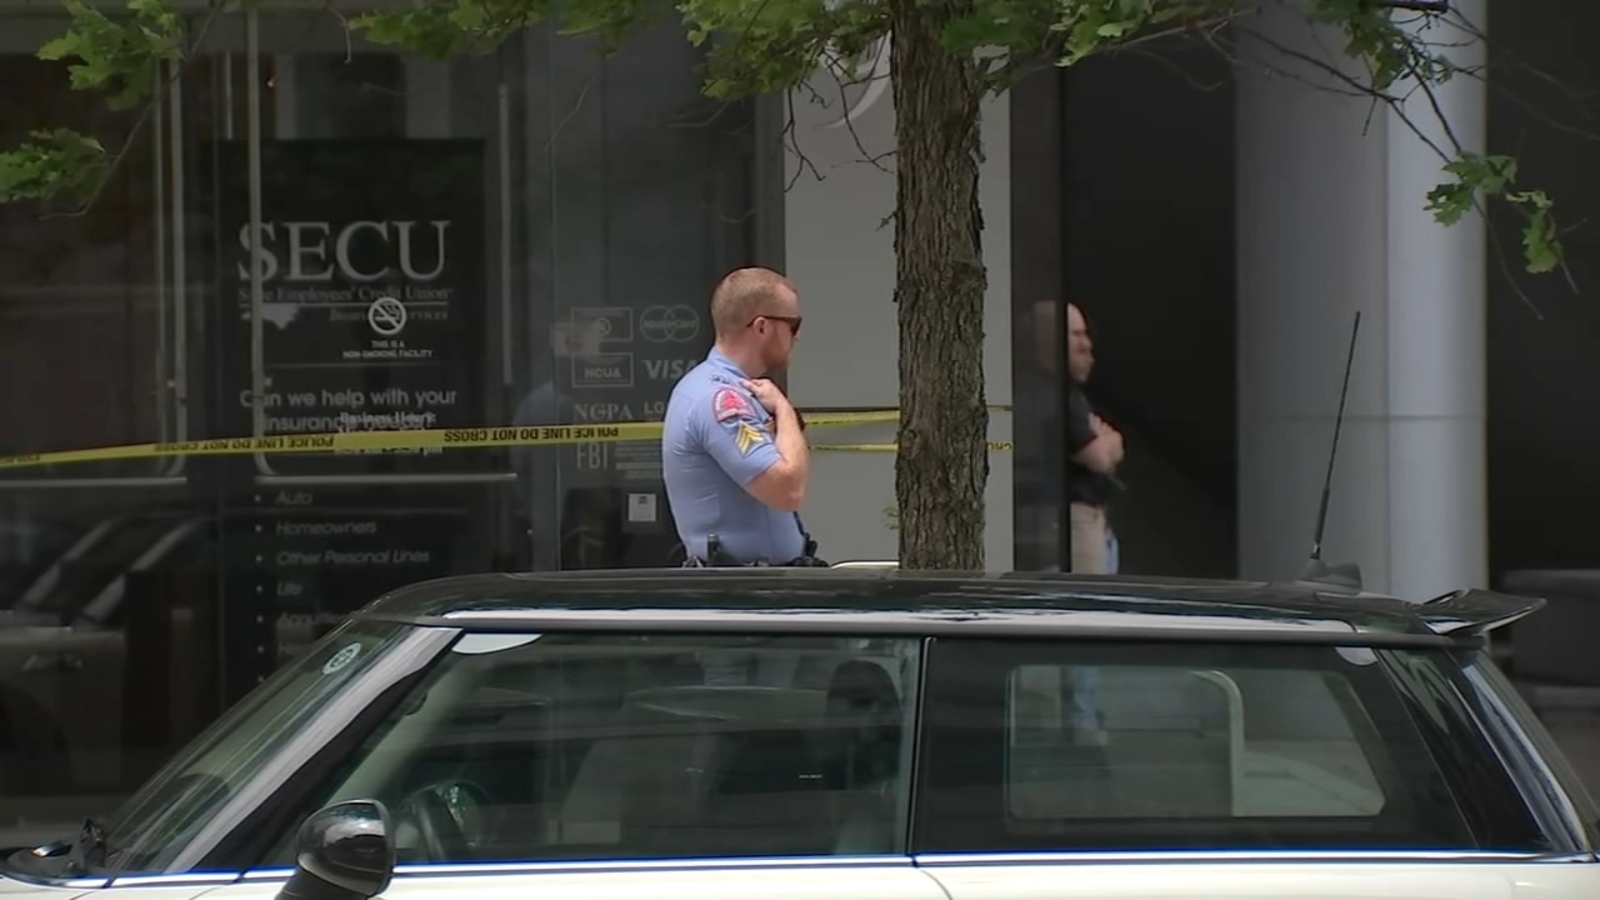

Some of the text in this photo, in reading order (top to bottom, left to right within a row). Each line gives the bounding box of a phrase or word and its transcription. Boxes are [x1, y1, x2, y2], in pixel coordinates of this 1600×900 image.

[238, 219, 450, 281] SECU
[405, 285, 448, 299] Union
[584, 367, 622, 379] NCUA
[287, 392, 317, 407] we
[321, 389, 364, 409] help
[370, 388, 409, 406] with
[415, 388, 458, 408] your
[574, 403, 634, 421] NGPA
[288, 435, 335, 449] POLICE
[444, 427, 619, 443] POLICE LINE DO NOT CROSS
[203, 442, 228, 450] NOT
[231, 440, 251, 450] DO
[256, 437, 284, 449] LINE
[275, 491, 313, 505] Auto
[276, 521, 377, 535] Homeowners
[276, 550, 430, 565] Other Personal Lines
